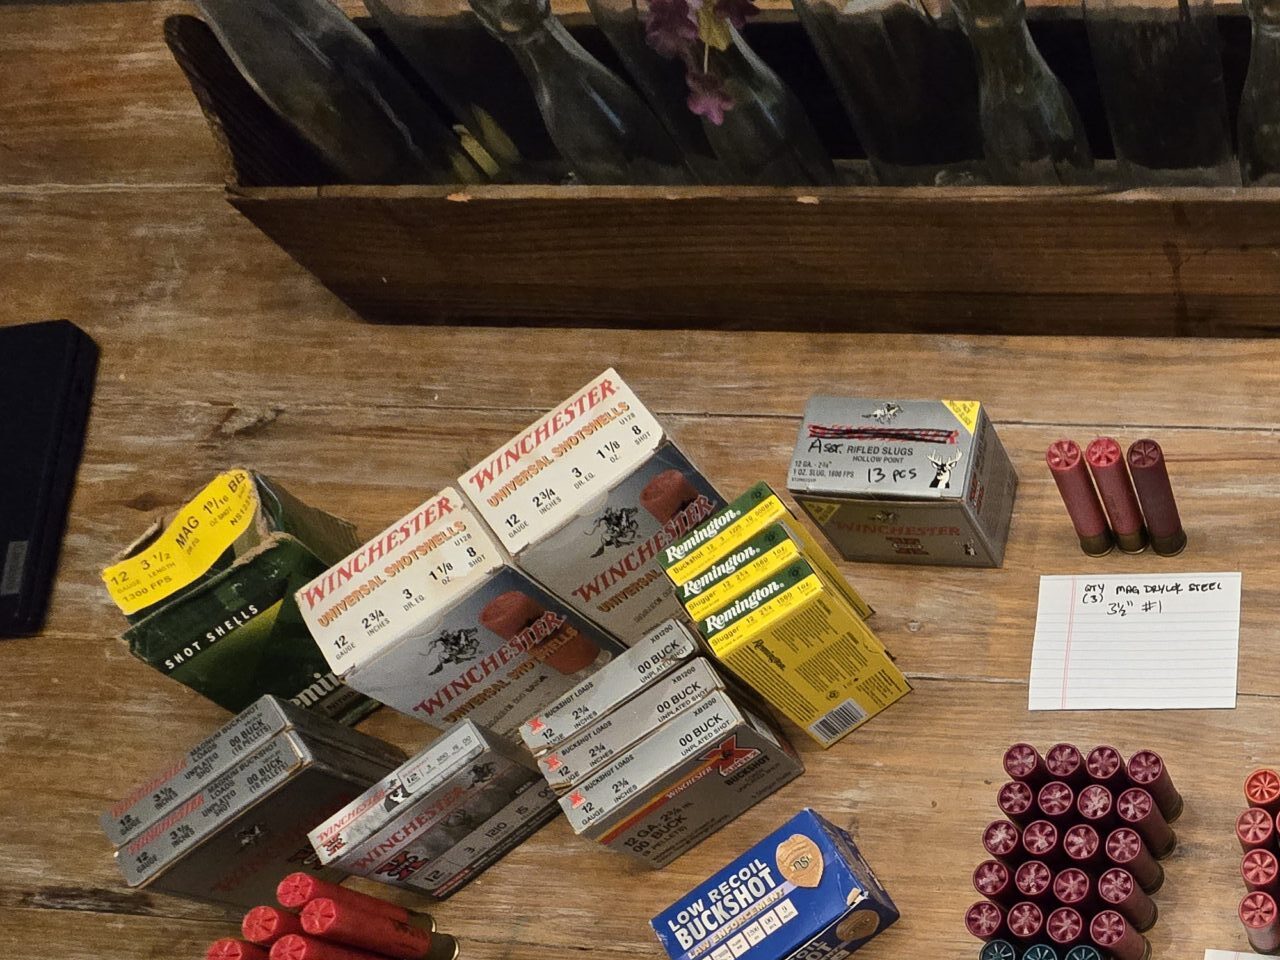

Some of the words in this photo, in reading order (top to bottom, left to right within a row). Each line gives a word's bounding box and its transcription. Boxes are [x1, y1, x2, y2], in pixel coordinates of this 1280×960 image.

[469, 378, 617, 493] WINCHESTER
[486, 454, 555, 508] UNIVERSAL
[551, 401, 631, 458] SHOTSHELLS
[846, 445, 880, 455] RIFLED
[881, 446, 914, 456] SLUGS
[505, 513, 521, 528] 12
[571, 467, 583, 479] 3
[631, 425, 642, 436] 8
[852, 455, 883, 463] HOLLOW
[883, 456, 904, 464] POINT
[867, 467, 886, 484] 13
[111, 571, 130, 586] 12
[175, 515, 200, 550] MAG
[228, 473, 246, 494] BB
[571, 494, 715, 602] WINCHESTER
[665, 509, 737, 564] Remington
[836, 522, 961, 537] WINCHESTER
[301, 495, 454, 611] WINCHESTER
[673, 551, 704, 574] Buckshot
[683, 546, 756, 598] Remington
[317, 575, 386, 628] UNIVERSAL
[384, 520, 468, 578] SHOTSHELLS
[597, 569, 663, 613] UNIVERSAL
[1085, 583, 1105, 594] QTY
[1116, 584, 1140, 595] MAG
[1188, 581, 1223, 592] STEEL
[333, 635, 349, 649] 12
[402, 588, 413, 600] 3
[466, 546, 477, 558] 8
[688, 591, 717, 611] Slugger
[705, 581, 781, 634] Remington
[1082, 594, 1104, 604] (3)
[1141, 600, 1163, 613] #1
[165, 641, 202, 670] SHOT
[206, 604, 259, 643] SHELLS
[711, 626, 740, 646] Slugger
[412, 611, 564, 716] WINCHESTER
[542, 728, 554, 740] 12
[637, 660, 651, 674] 00
[650, 640, 681, 661] BUCK
[544, 694, 574, 719] BUCKSHOT
[574, 681, 594, 698] LOADS
[241, 720, 265, 739] BUCK
[558, 765, 571, 777] 12
[656, 700, 671, 714] 00
[671, 681, 702, 703] BUCK
[561, 733, 592, 756] BUCKSHOT
[592, 720, 613, 735] LOADS
[573, 711, 598, 729] INCHES
[589, 749, 614, 768] INCHES
[657, 699, 691, 723] UNPLATED
[691, 687, 709, 702] SHOT
[258, 757, 283, 778] BUCK
[581, 807, 605, 826] GAUGE
[613, 784, 638, 804] INCHES
[681, 732, 714, 757] UNPLATED
[713, 720, 731, 734] SHOT
[582, 801, 595, 814] 12
[679, 733, 693, 747] 00
[692, 713, 724, 738] BUCK
[584, 767, 614, 792] BUCKSHOT
[614, 754, 635, 771] LOADS
[667, 766, 713, 799] WINCHESTER
[724, 755, 771, 786] BUCKSHOT
[351, 785, 466, 870] WINCHESTER
[624, 836, 638, 847] 12
[650, 814, 688, 840] BUCK
[136, 851, 149, 864] 12
[424, 870, 445, 883] 12
[667, 899, 705, 932] LOW
[707, 858, 767, 903] RECOIL
[674, 867, 776, 951] BUCKSHOT
[688, 939, 711, 960] LAW
[713, 887, 785, 944] ENFORCEMENT
